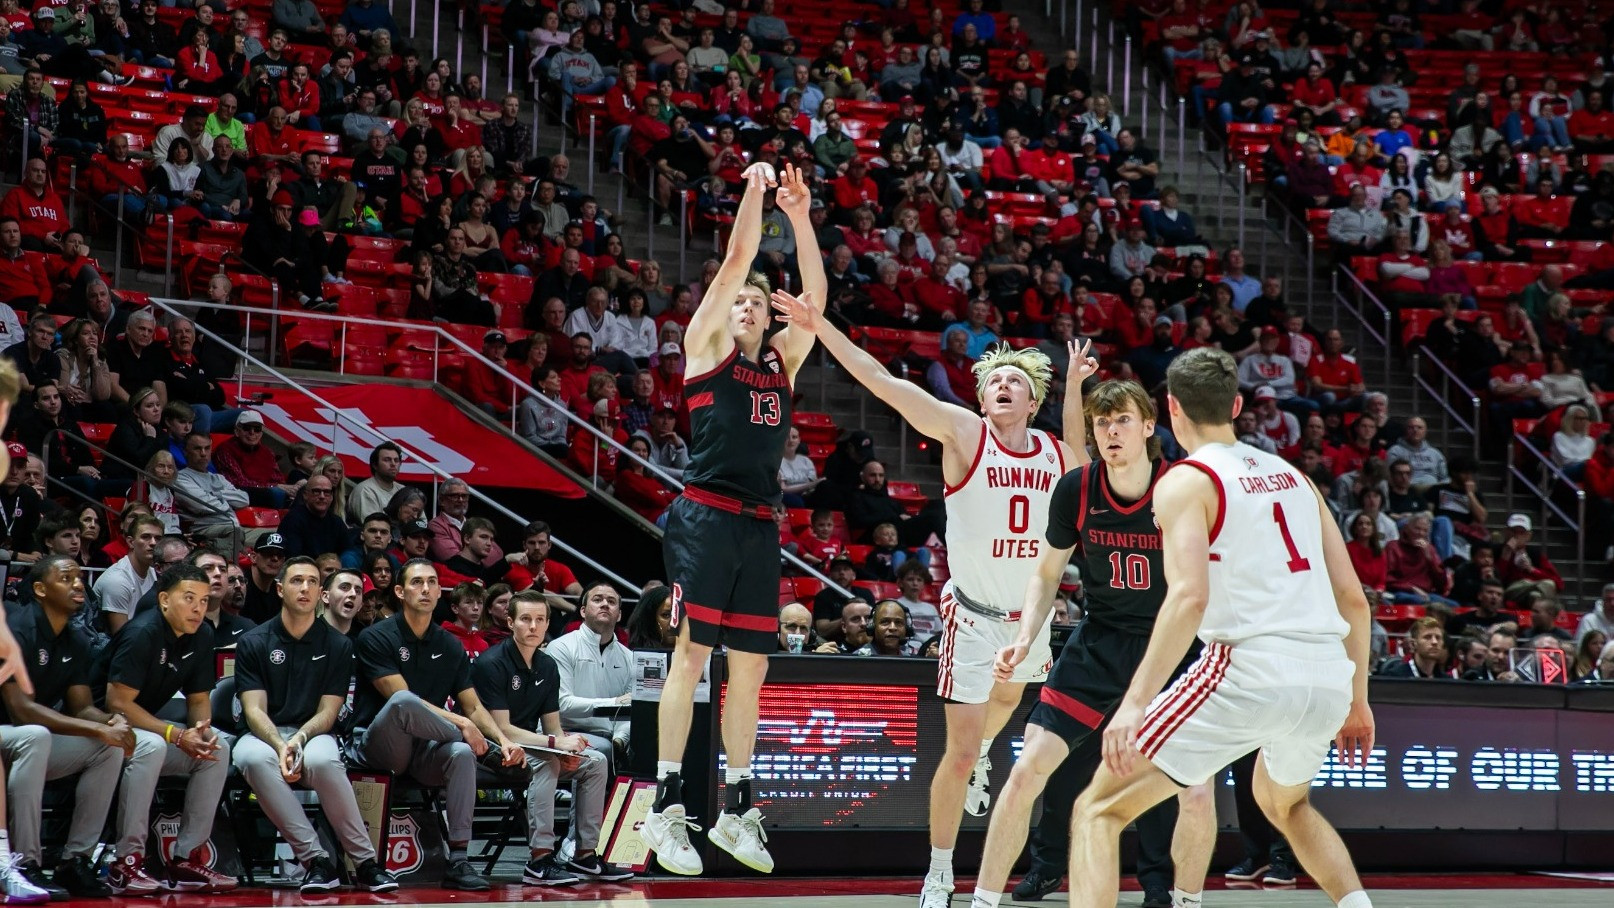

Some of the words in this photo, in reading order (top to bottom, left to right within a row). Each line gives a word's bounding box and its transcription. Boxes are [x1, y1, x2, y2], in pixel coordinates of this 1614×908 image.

[29, 206, 57, 221] UTAH
[750, 390, 781, 426] 13
[986, 466, 1056, 493] RUNNIN'
[1239, 472, 1299, 494] CARLSON
[1009, 494, 1030, 534] 0
[992, 538, 1040, 558] UTES
[1273, 501, 1311, 573] 1
[1109, 551, 1151, 590] 10
[1402, 745, 1458, 789] OF
[1471, 747, 1561, 791] OUR
